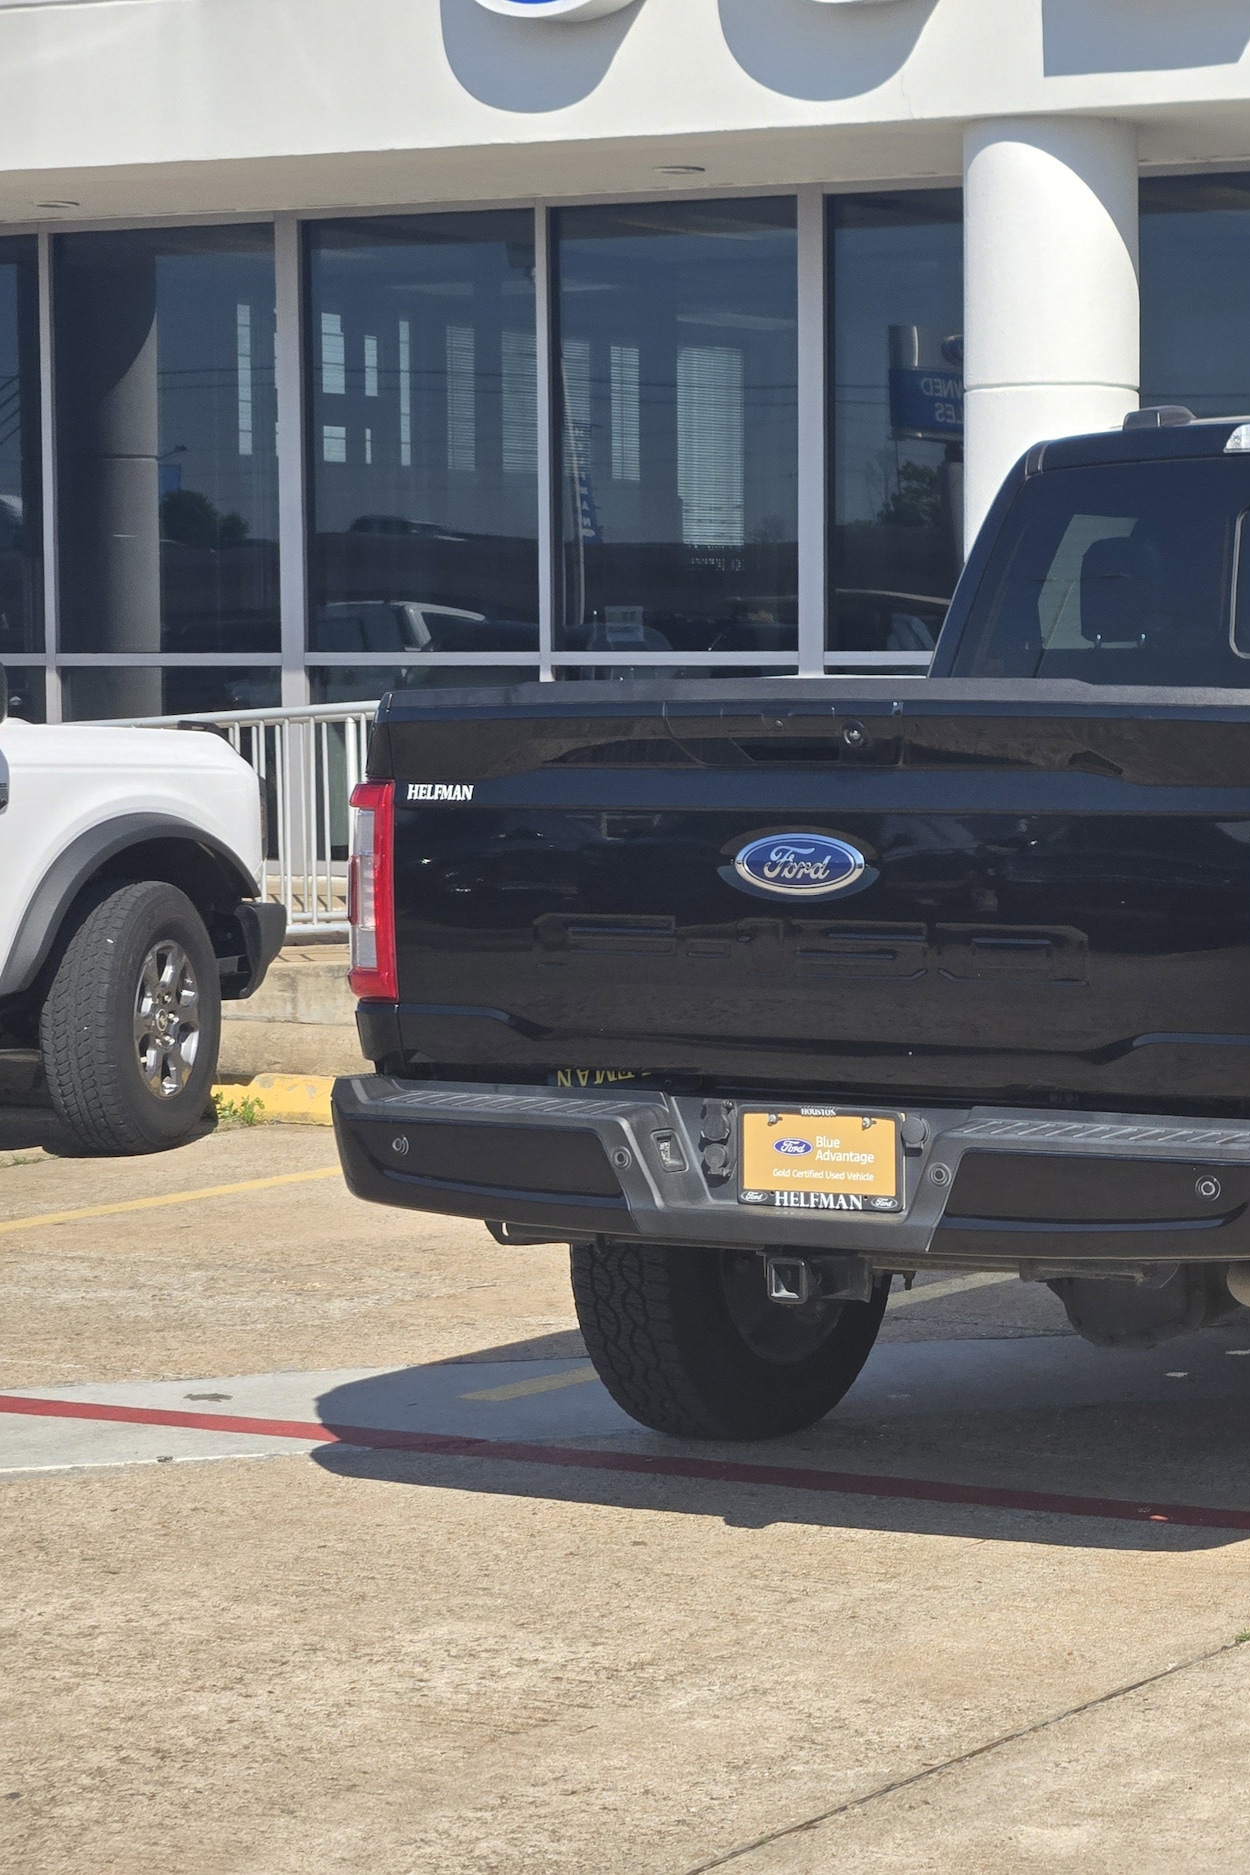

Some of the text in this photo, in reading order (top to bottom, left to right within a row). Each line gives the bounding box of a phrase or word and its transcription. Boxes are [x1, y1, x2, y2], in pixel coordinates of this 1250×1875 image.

[406, 783, 475, 801] HELFMAN
[815, 1136, 841, 1149] Blue
[815, 1150, 875, 1165] Advantage
[773, 1168, 875, 1182] Gold Certified Used Vehicle
[774, 1191, 863, 1211] HELFMAN
